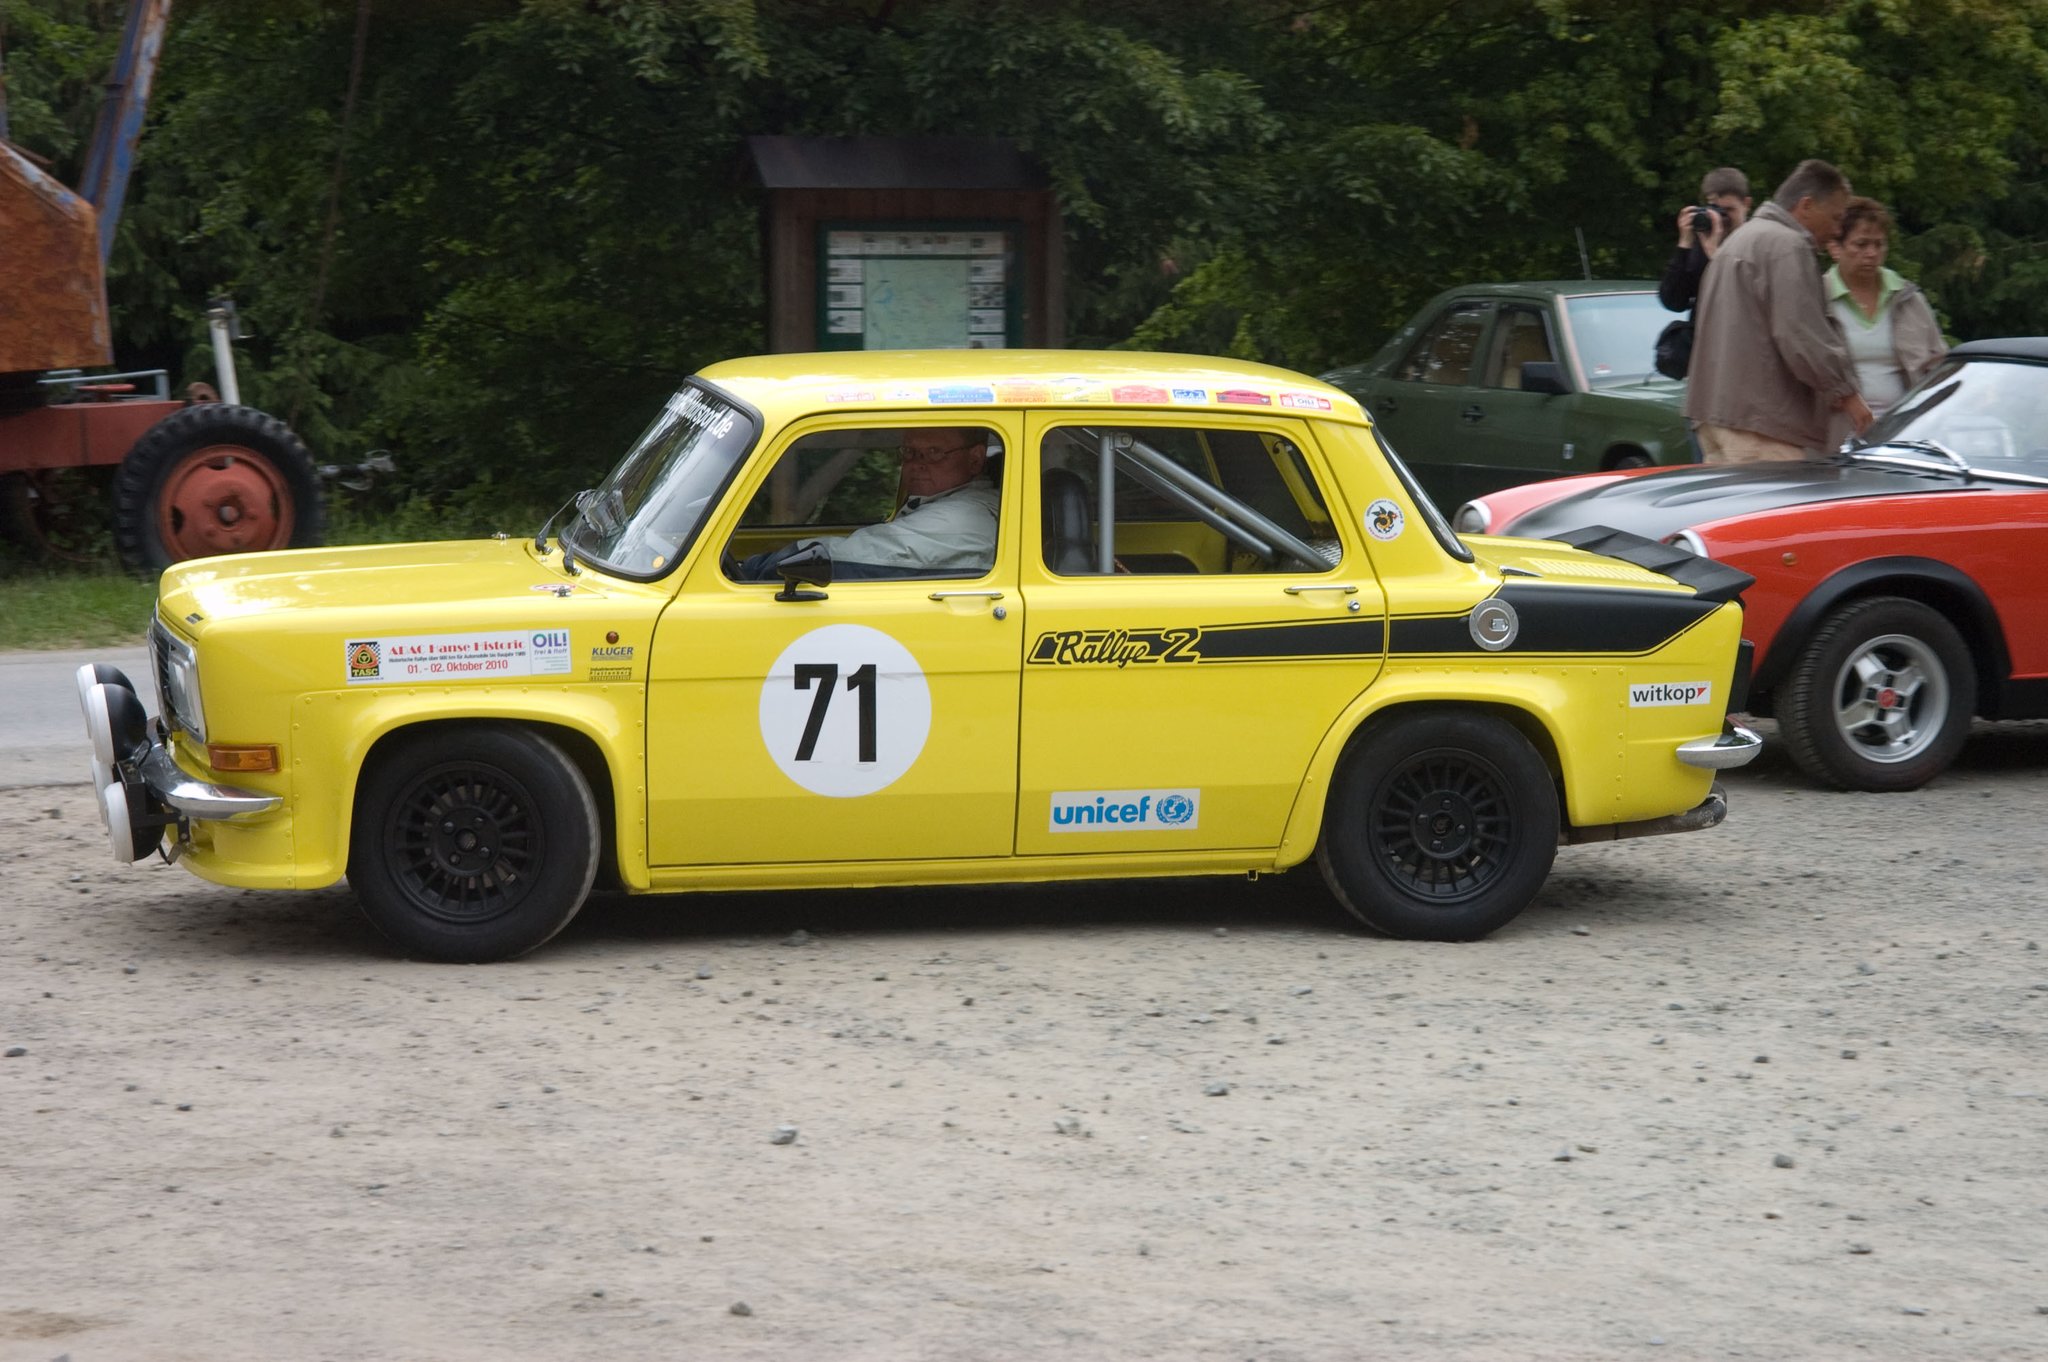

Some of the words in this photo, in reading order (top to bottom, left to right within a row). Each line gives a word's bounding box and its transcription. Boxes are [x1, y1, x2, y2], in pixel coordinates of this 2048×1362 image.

[533, 632, 568, 648] OIL!
[1056, 630, 1158, 669] Rallye
[1162, 627, 1199, 663] 2
[592, 646, 634, 656] KLUGER
[352, 668, 379, 677] TASC
[446, 661, 483, 673] Oktober
[485, 659, 509, 671] 2010
[1632, 684, 1696, 704] witkop
[793, 662, 878, 763] 71
[1053, 795, 1151, 825] unicef
